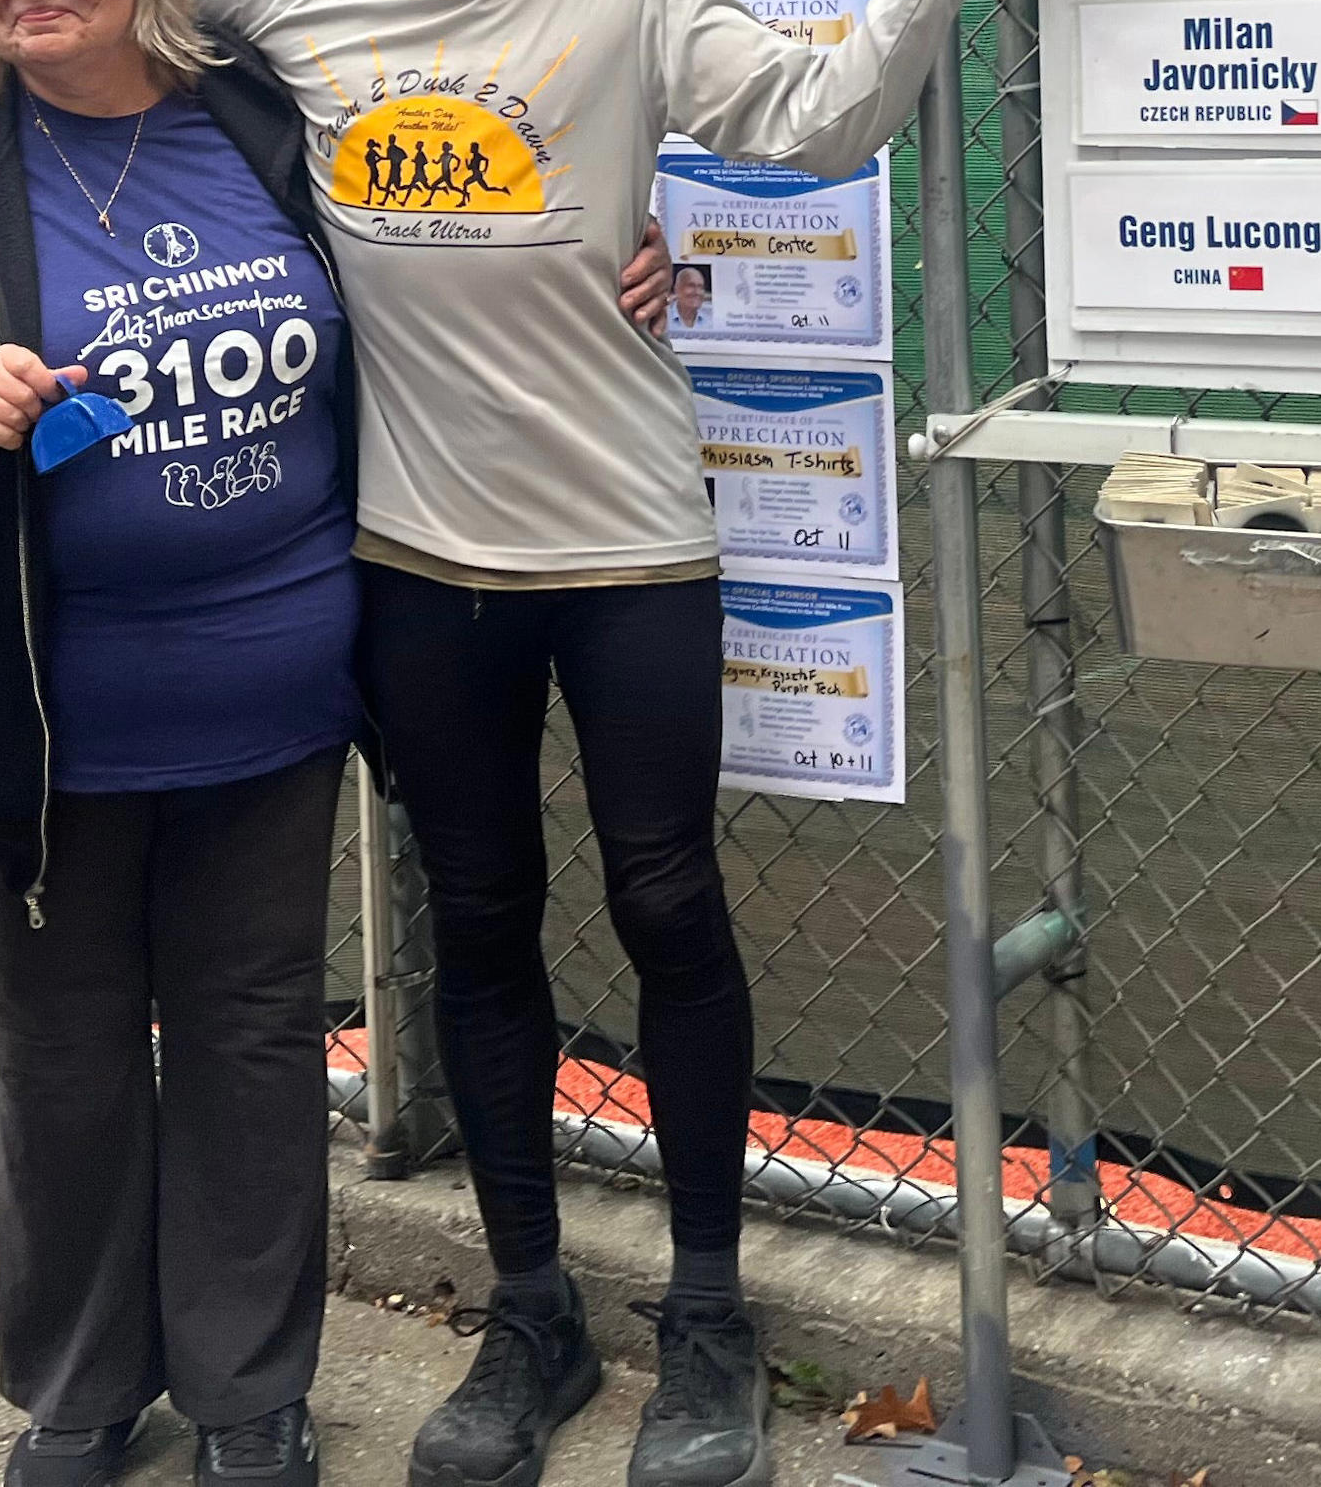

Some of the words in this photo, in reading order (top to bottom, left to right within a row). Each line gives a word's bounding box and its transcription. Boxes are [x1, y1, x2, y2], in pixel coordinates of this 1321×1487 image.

[752, 0, 840, 16] CIATION
[1183, 17, 1273, 51] Milan
[1143, 56, 1318, 94] Javornicky
[396, 69, 469, 96] Dusk
[498, 95, 552, 164] Dawn
[1139, 105, 1190, 123] CZECH
[1195, 104, 1273, 122] REPUBLIC
[794, 200, 808, 210] OF
[371, 216, 423, 239] Track
[428, 218, 494, 240] Ultras
[687, 212, 840, 230] APPRECIATION
[692, 231, 756, 255] Kingston
[768, 235, 818, 254] Centre
[1118, 214, 1196, 253] Geng
[1206, 214, 1321, 254] Lucong
[82, 283, 139, 313] SRI
[142, 255, 289, 301] CHINMOY
[1173, 269, 1223, 286] CHINA
[77, 289, 308, 361] Self-Transcendence
[98, 318, 318, 416] 3100
[111, 413, 208, 458] MILE
[221, 386, 306, 440] RACE
[700, 446, 774, 469] thusiasm
[794, 528, 824, 546] Oct
[722, 640, 852, 666] PRECIATION
[794, 750, 818, 768] Oct
